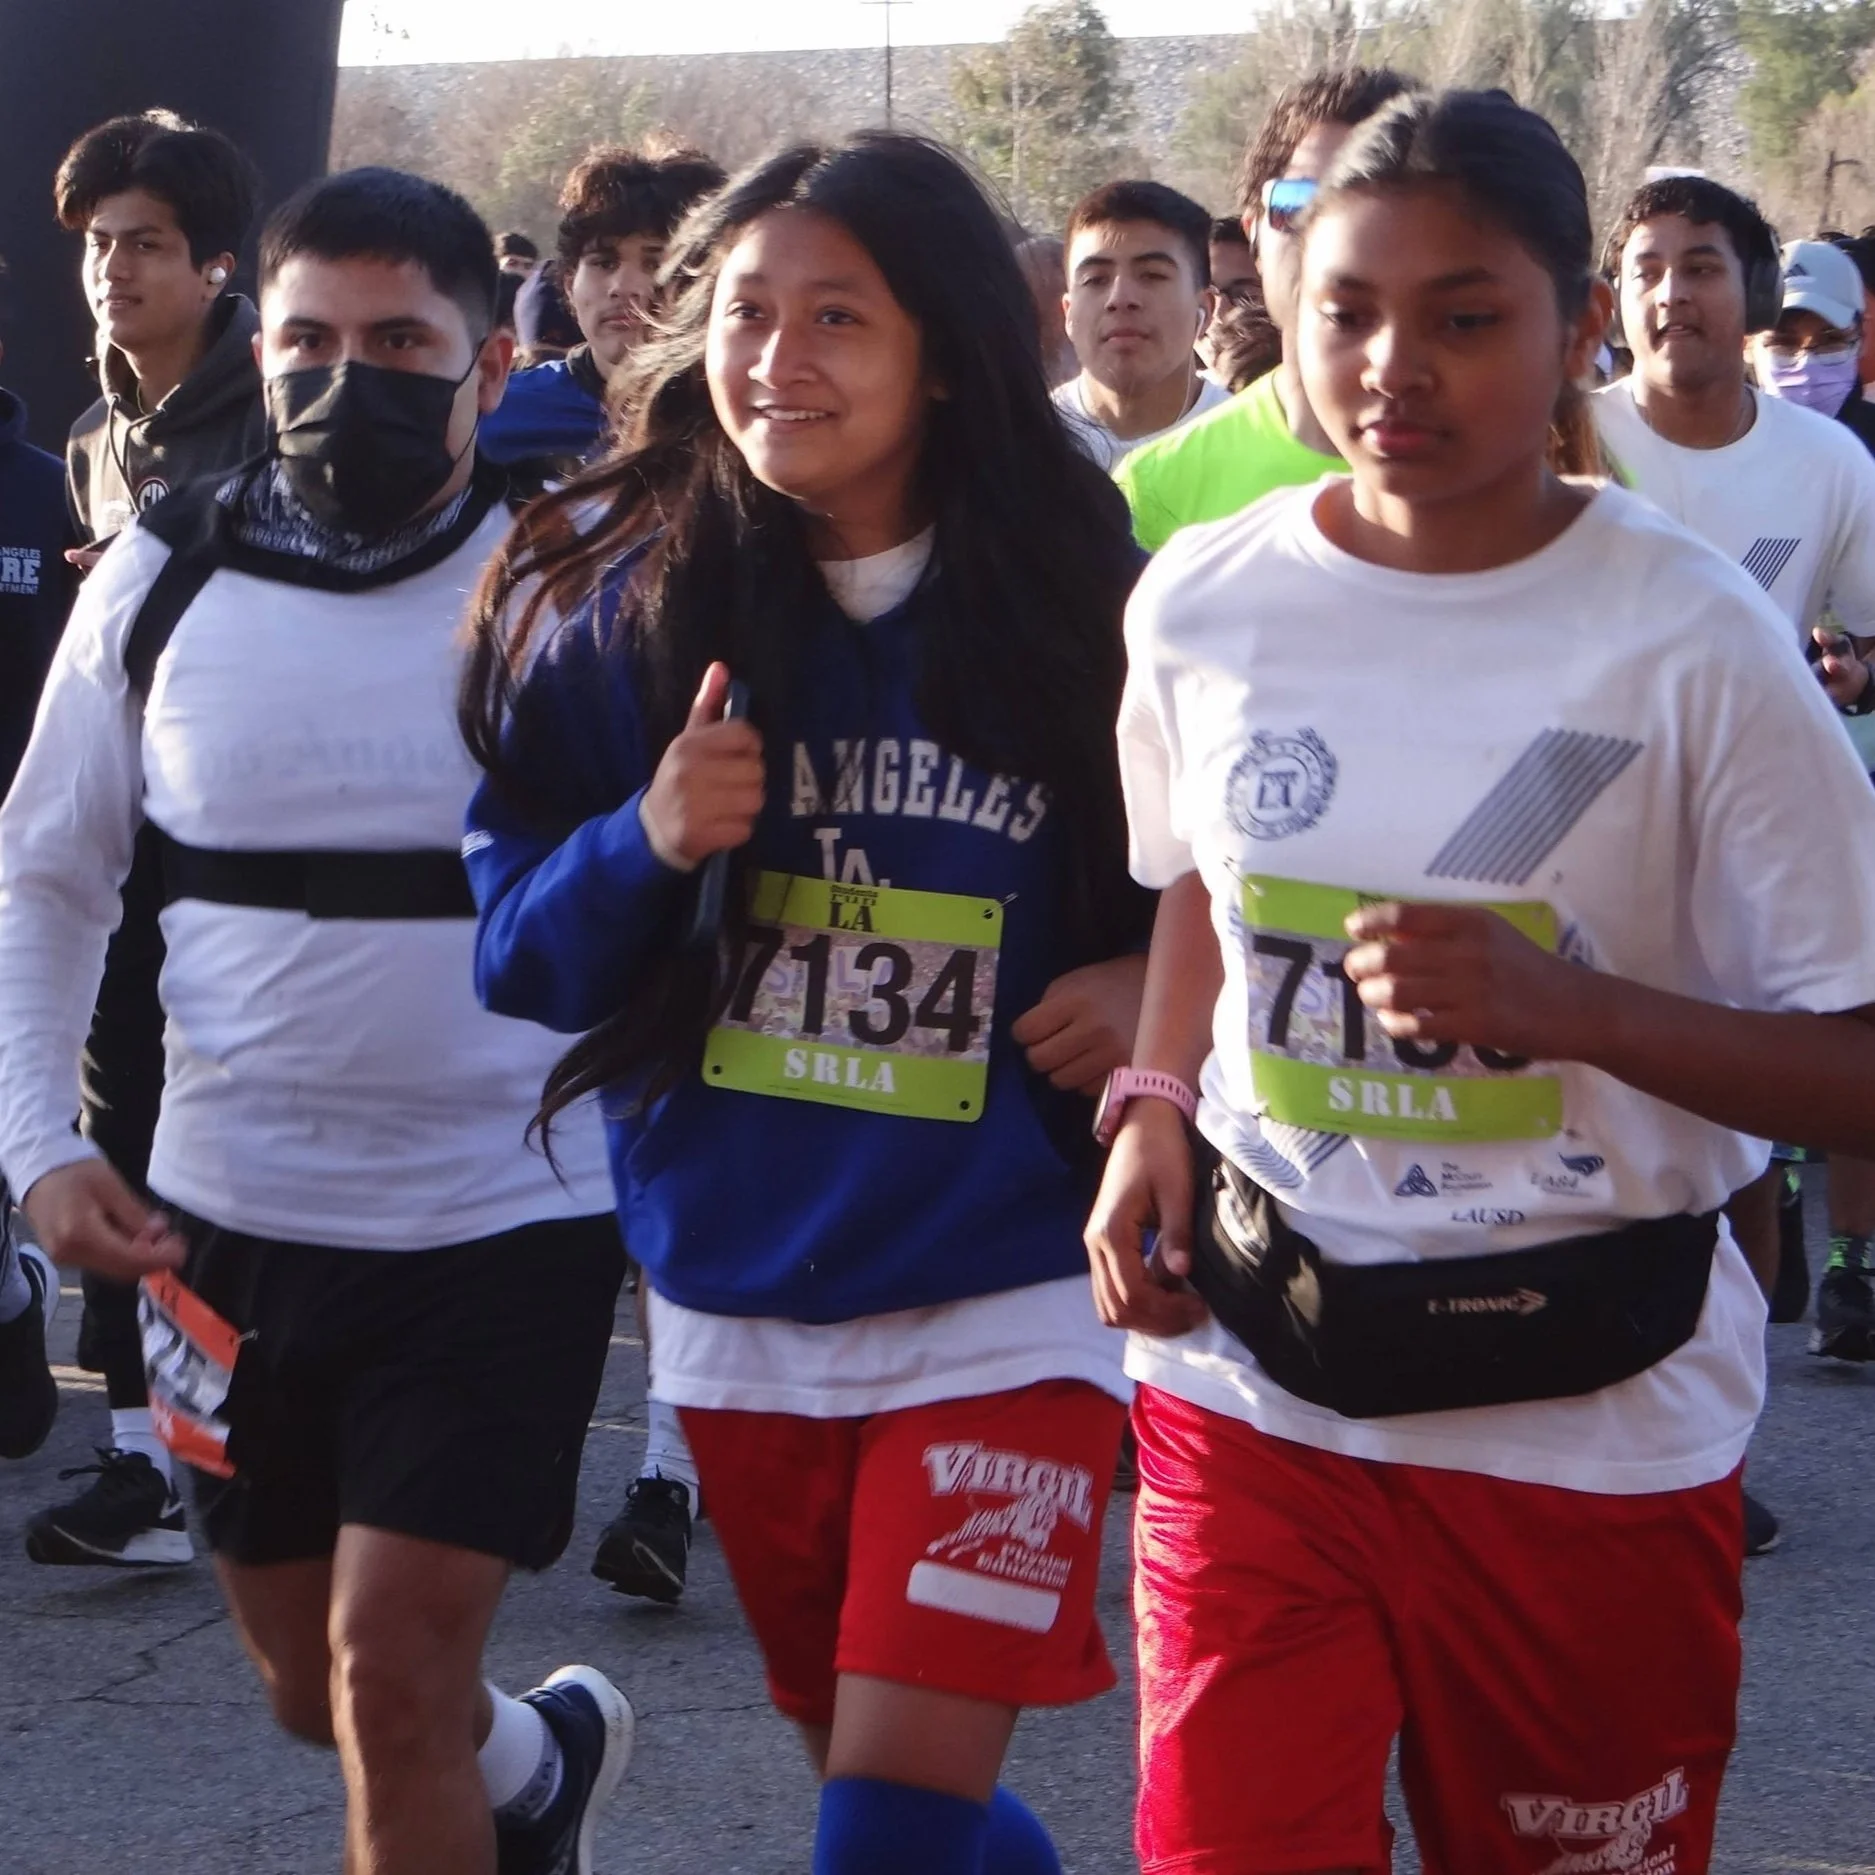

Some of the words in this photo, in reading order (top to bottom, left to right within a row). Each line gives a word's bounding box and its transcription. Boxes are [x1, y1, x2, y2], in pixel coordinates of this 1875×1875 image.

[791, 738, 1050, 843] ANGELES
[827, 902, 875, 932] LA
[728, 929, 981, 1053] 7134
[1252, 934, 1535, 1071] 71
[784, 1048, 897, 1094] SRLA
[1328, 1076, 1458, 1121] SRLA
[1452, 1208, 1525, 1225] LAUSD
[1499, 1766, 1689, 1838] VIRGIL
